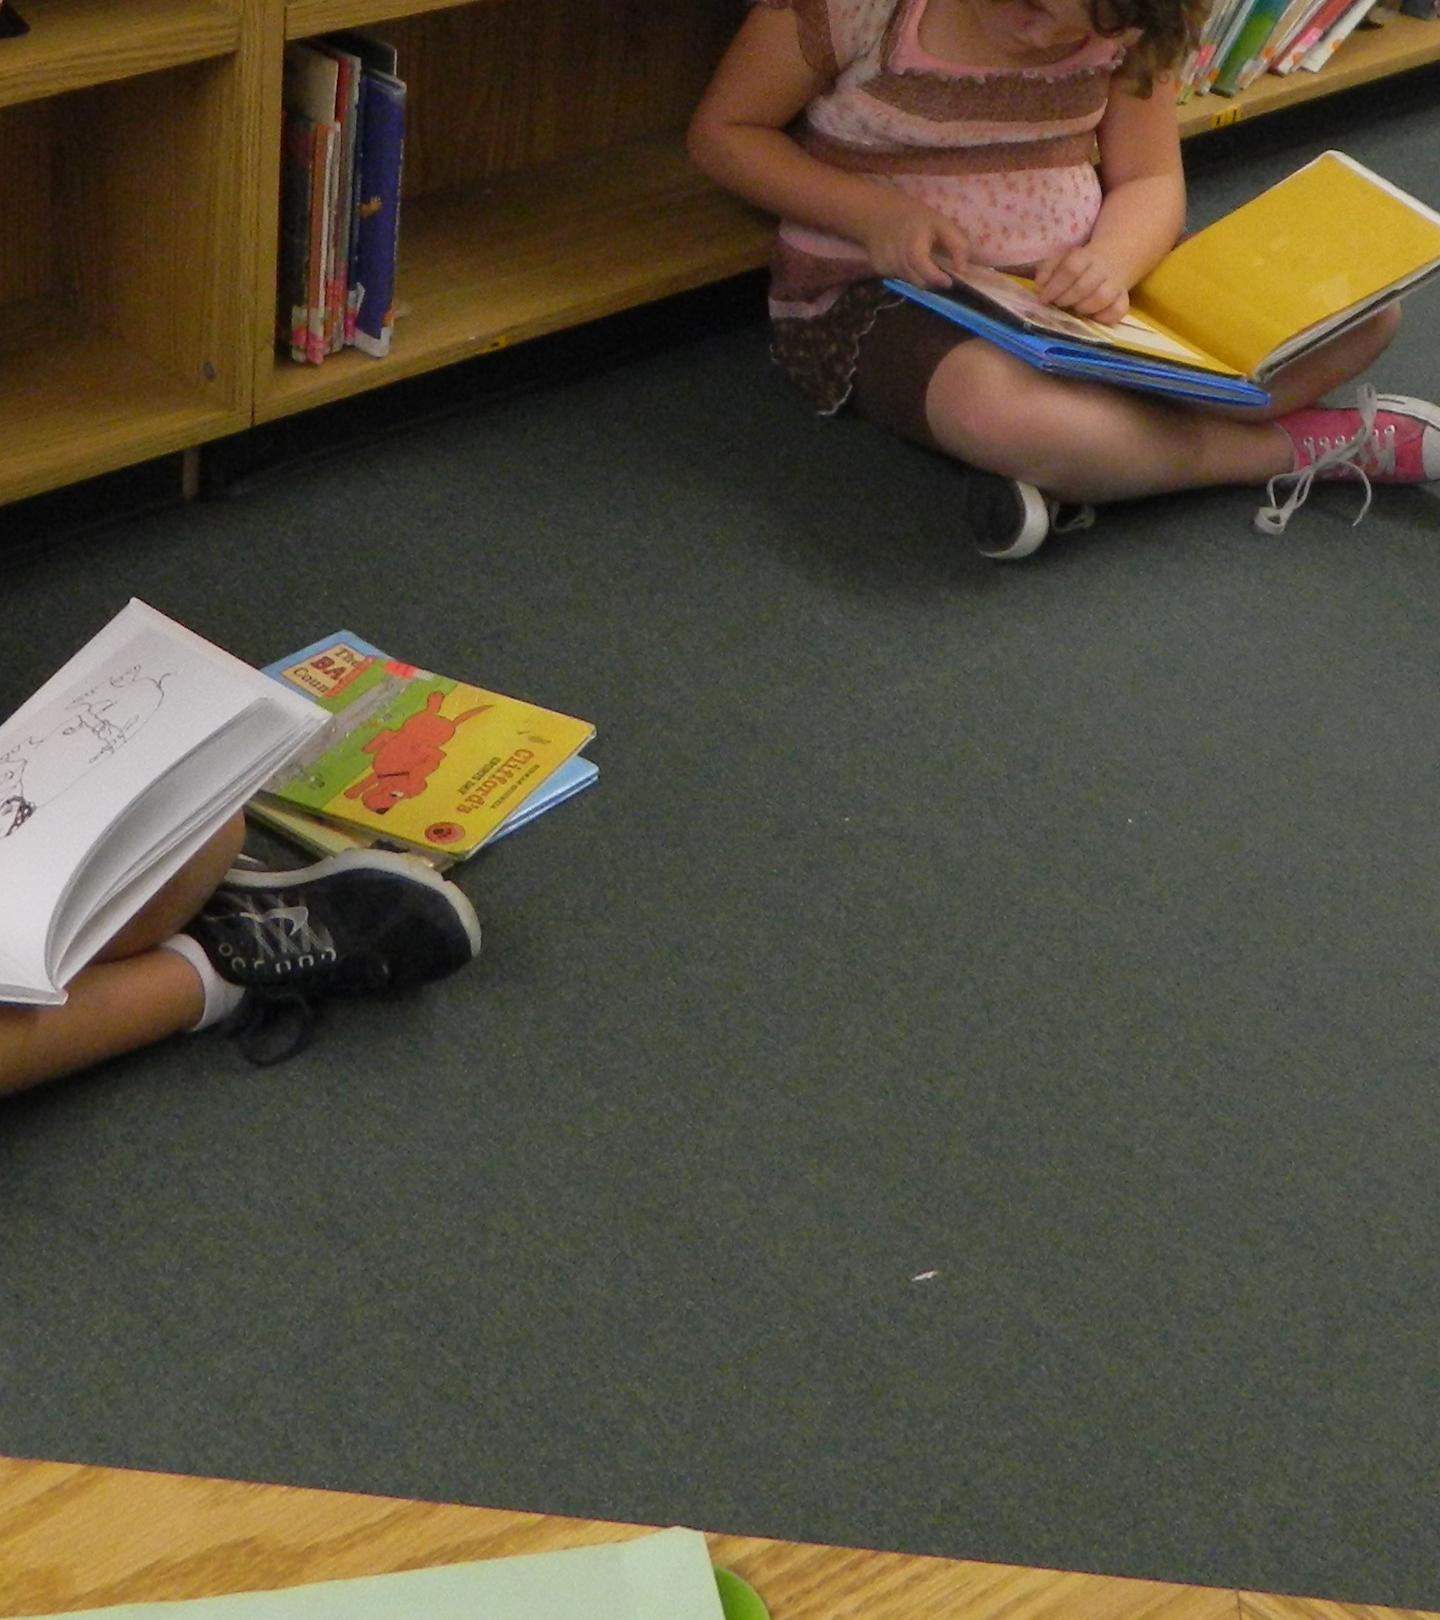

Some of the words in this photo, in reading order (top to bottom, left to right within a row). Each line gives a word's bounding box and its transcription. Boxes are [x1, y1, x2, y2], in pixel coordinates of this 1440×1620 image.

[310, 656, 345, 683] BA
[333, 646, 360, 669] The
[293, 667, 330, 694] Coun
[456, 743, 534, 822] Clifford's
